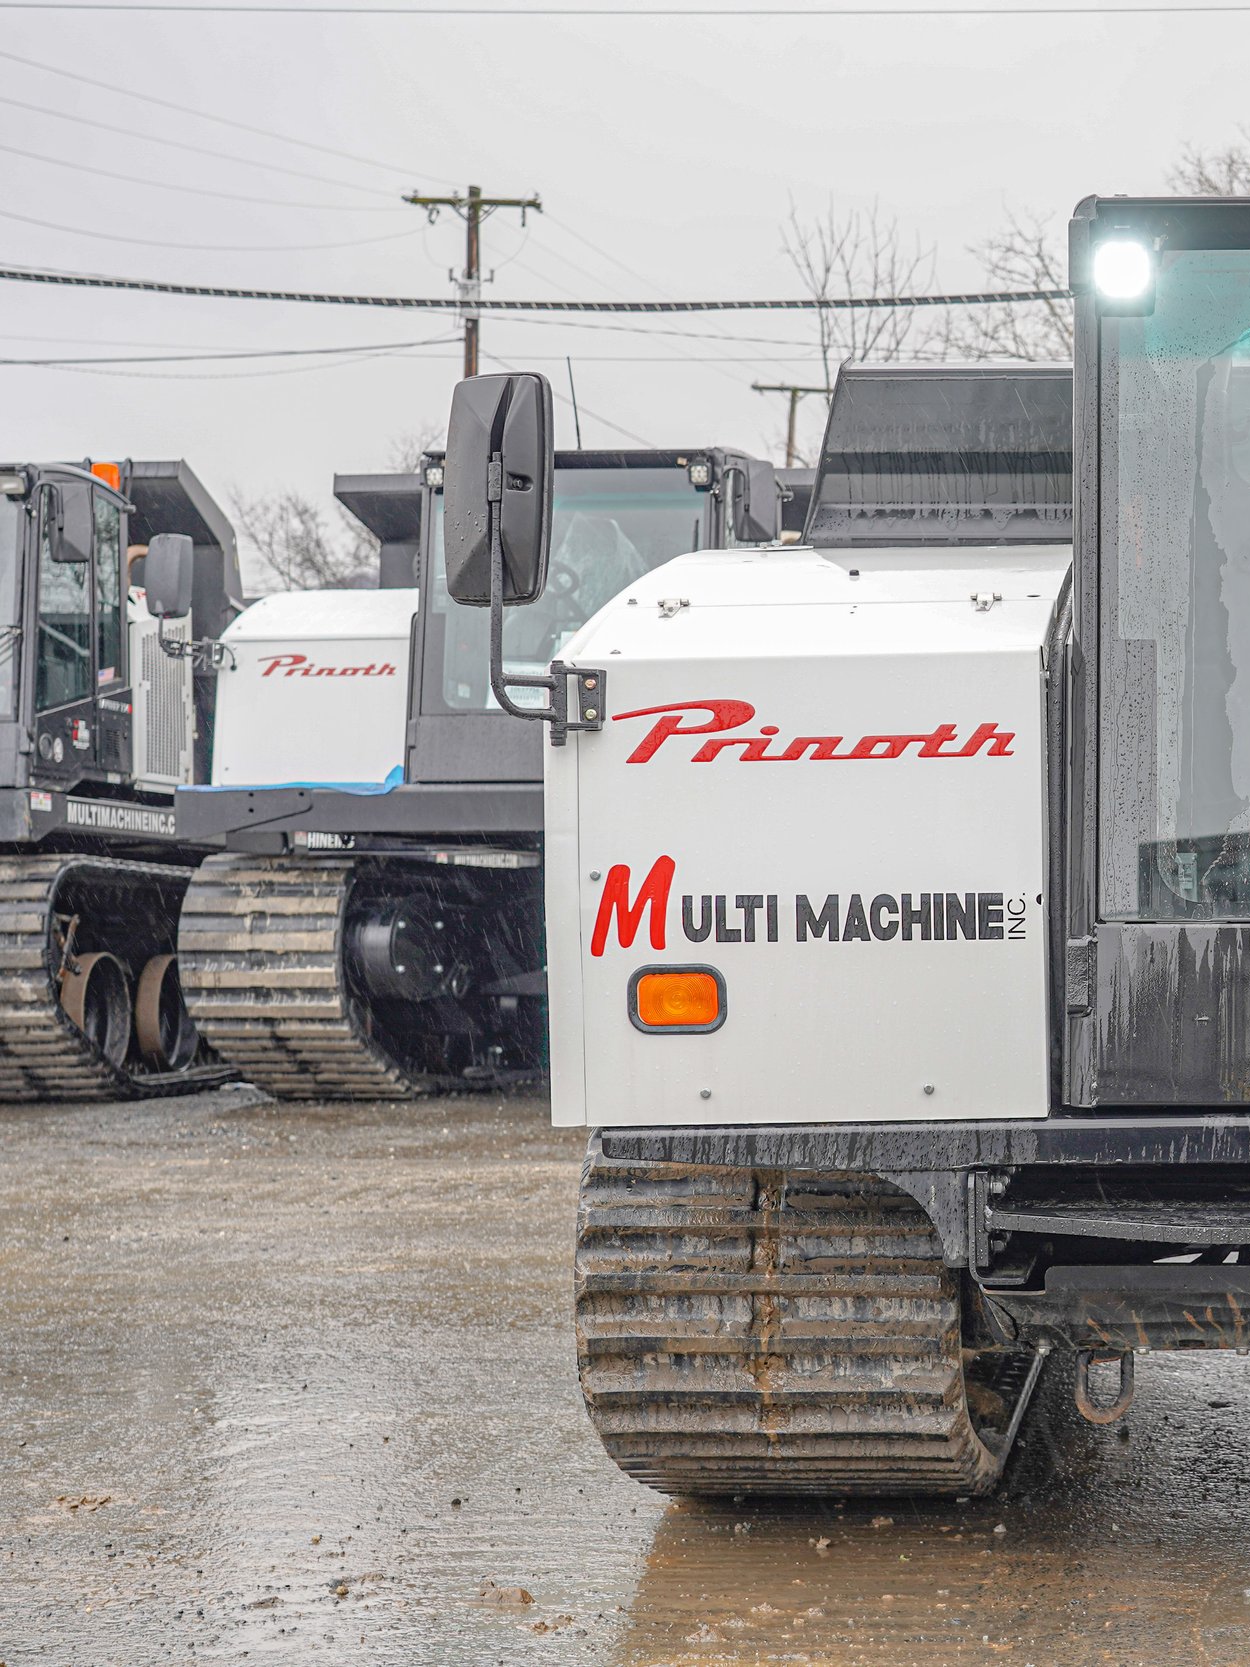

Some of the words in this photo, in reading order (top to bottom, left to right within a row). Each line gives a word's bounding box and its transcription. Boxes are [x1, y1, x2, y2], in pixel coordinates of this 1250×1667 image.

[258, 653, 396, 677] Prinoth
[612, 699, 1015, 764] Prinoth
[796, 893, 1004, 942] MACHINE
[1007, 892, 1026, 940] INC.
